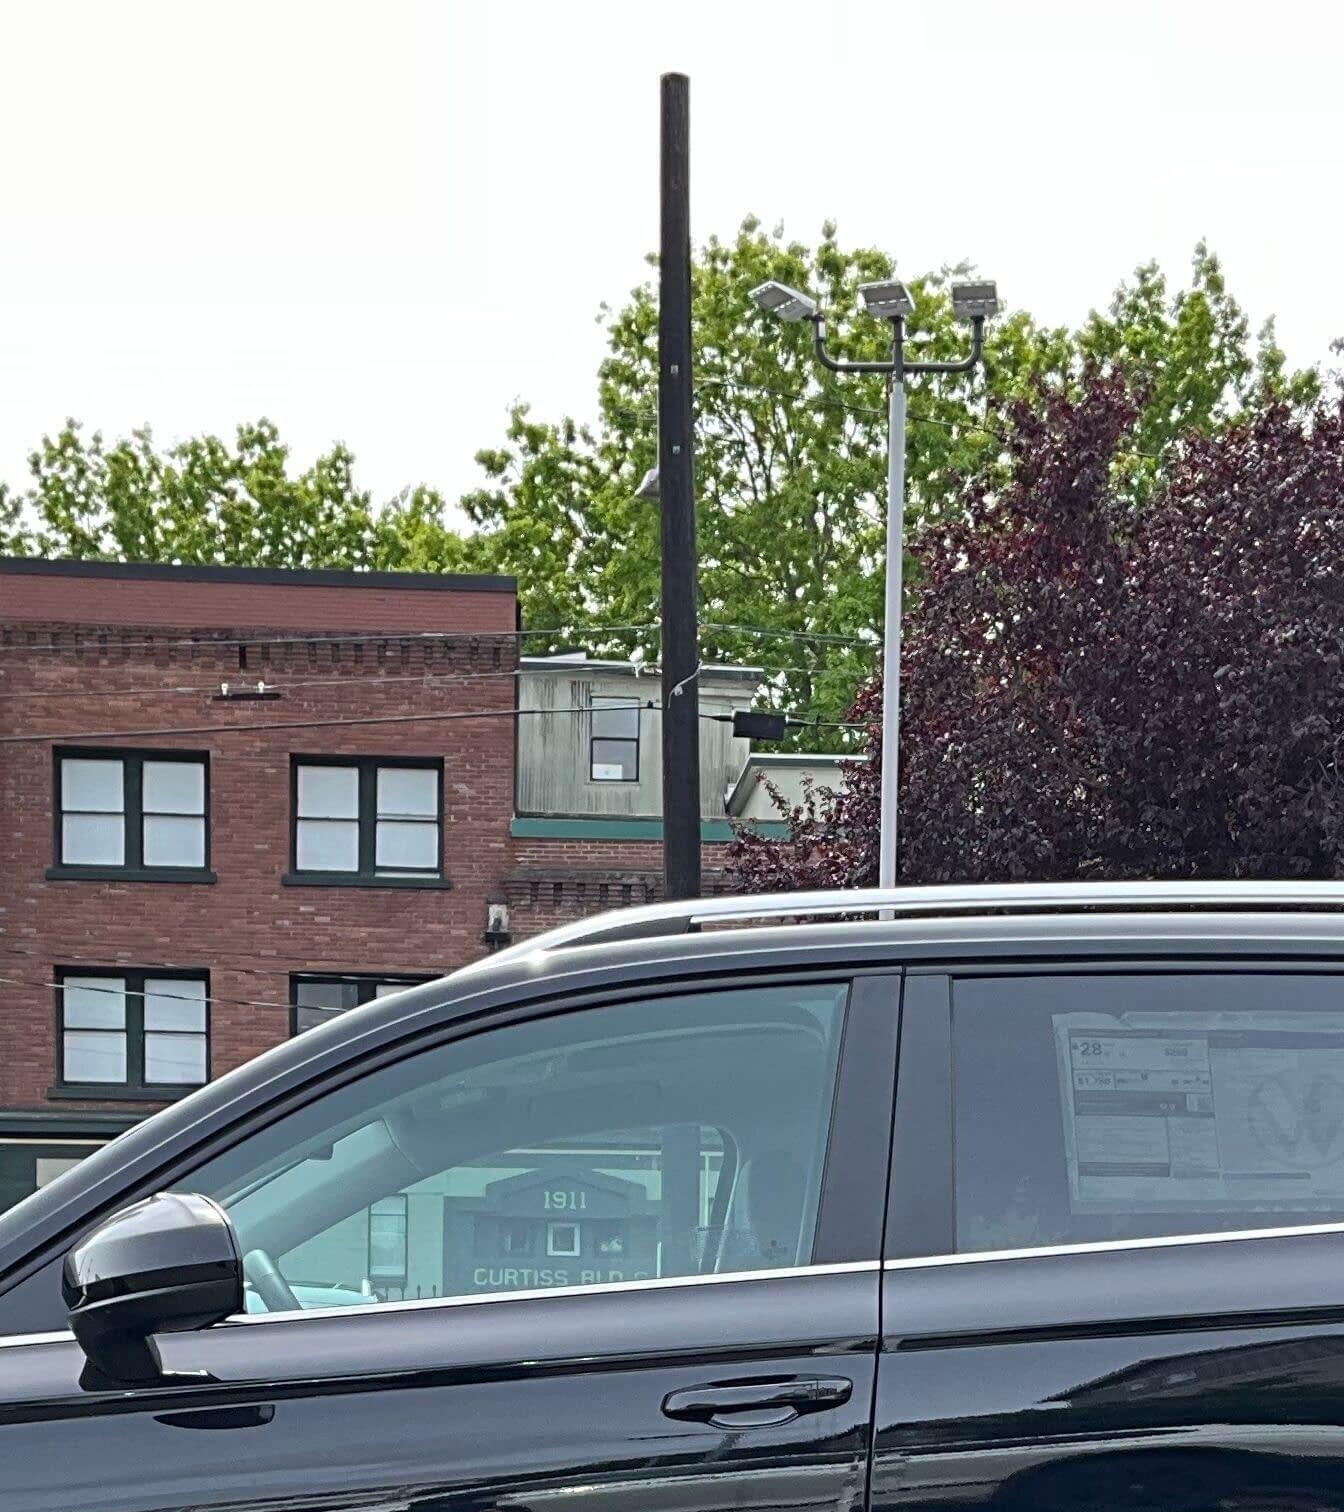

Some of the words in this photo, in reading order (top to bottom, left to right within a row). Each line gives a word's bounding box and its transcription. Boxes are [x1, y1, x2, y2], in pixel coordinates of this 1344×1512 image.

[1080, 1041, 1103, 1056] 28
[543, 1191, 587, 1209] 1911
[473, 1268, 568, 1286] CURTISS
